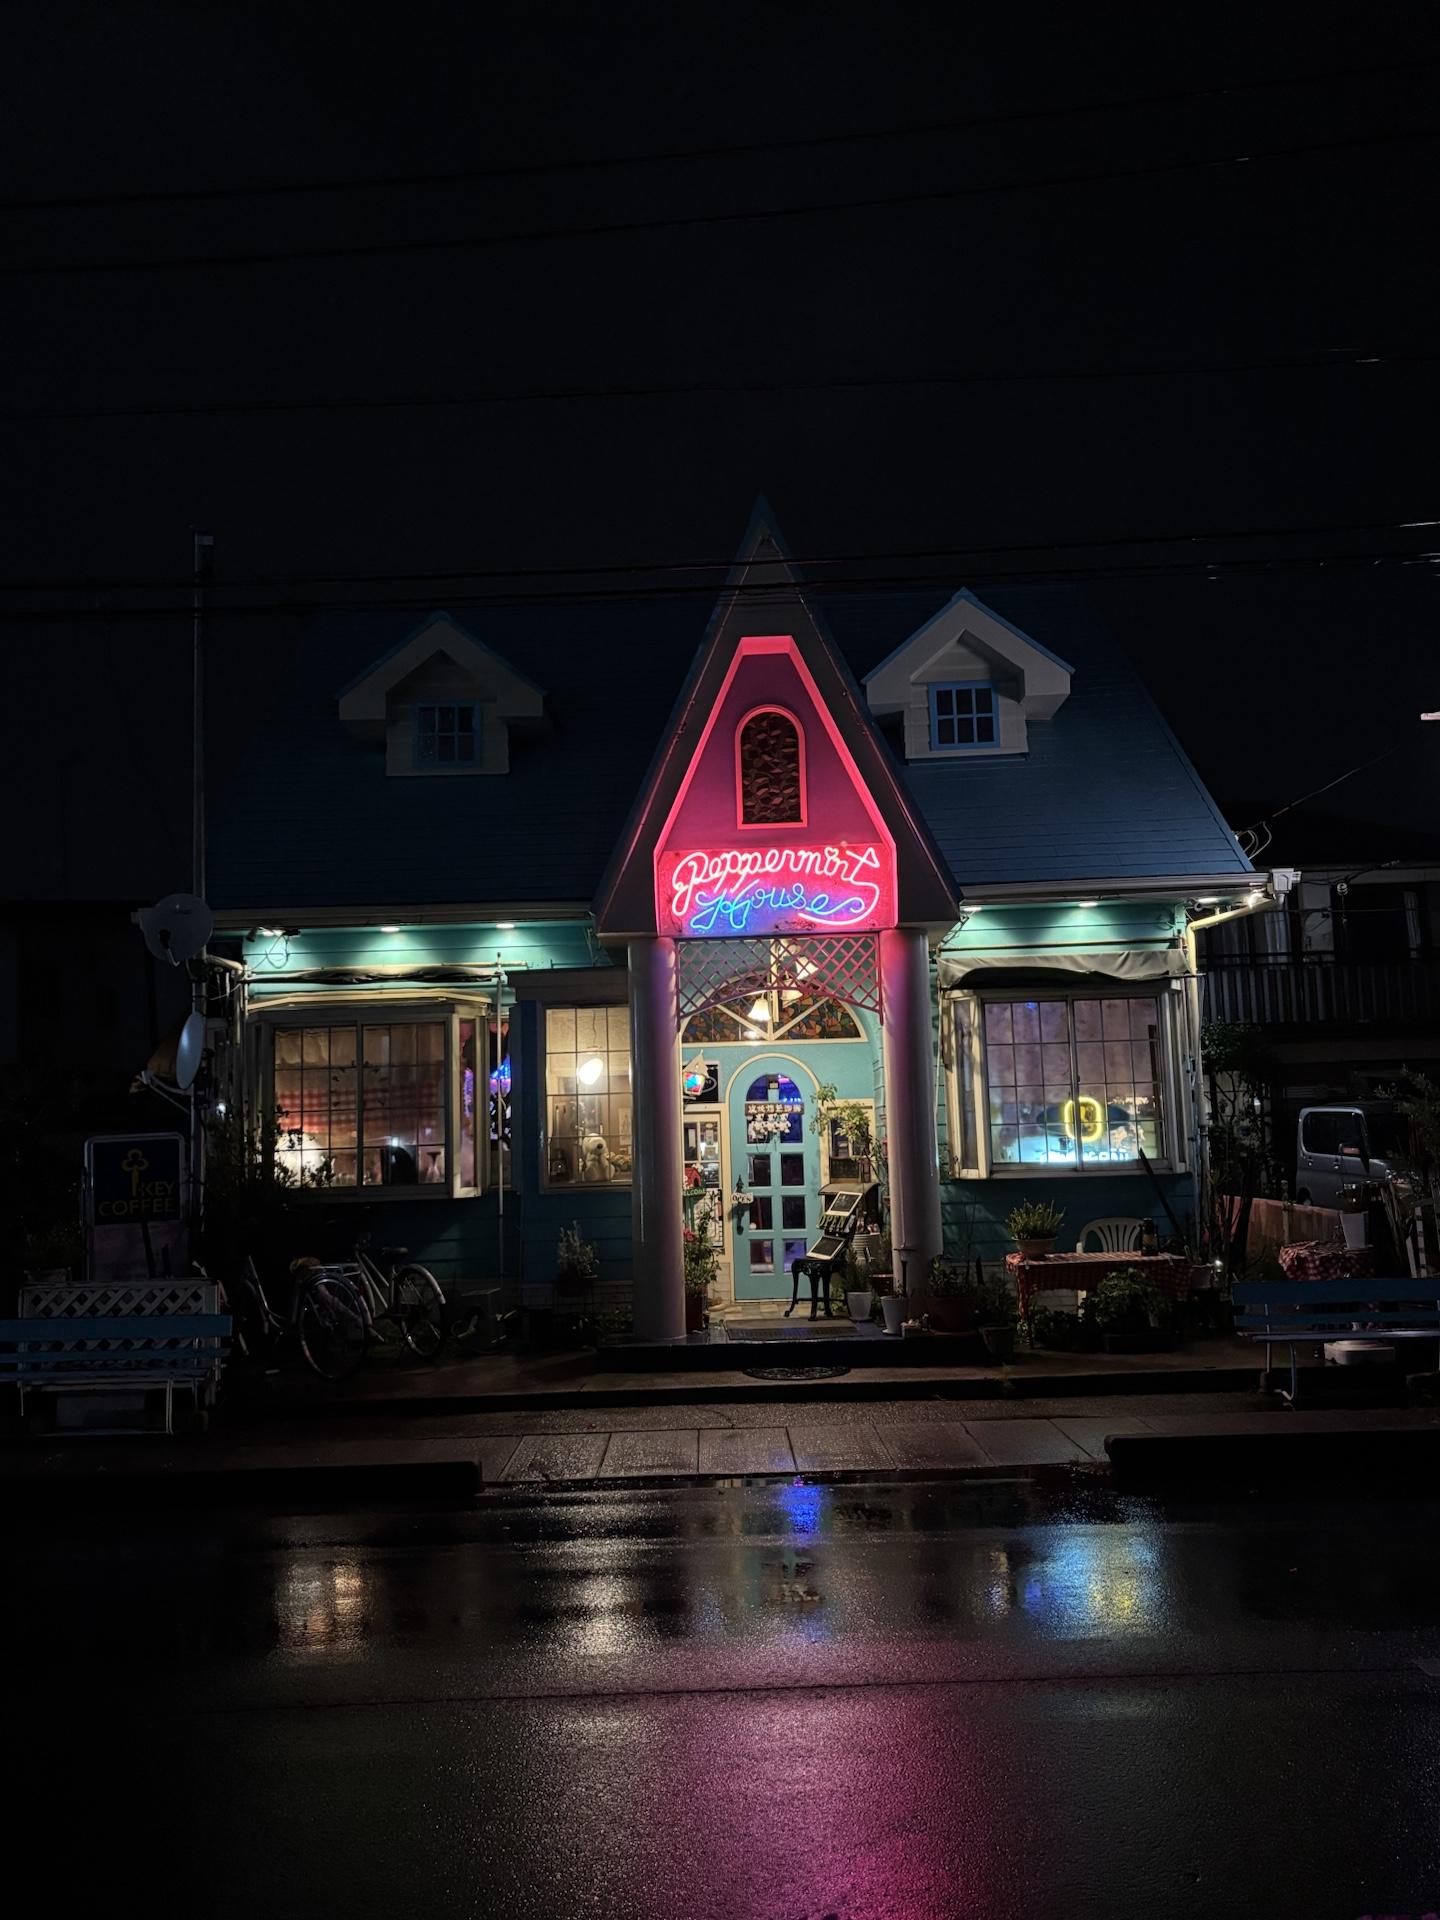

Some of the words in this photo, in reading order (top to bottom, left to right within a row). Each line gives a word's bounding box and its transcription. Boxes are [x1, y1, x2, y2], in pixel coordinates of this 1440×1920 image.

[671, 847, 881, 924] Peppermint
[690, 879, 866, 930] House
[139, 1180, 176, 1197] KEY
[732, 1193, 751, 1202] OPEN
[98, 1198, 177, 1217] COFFEE
